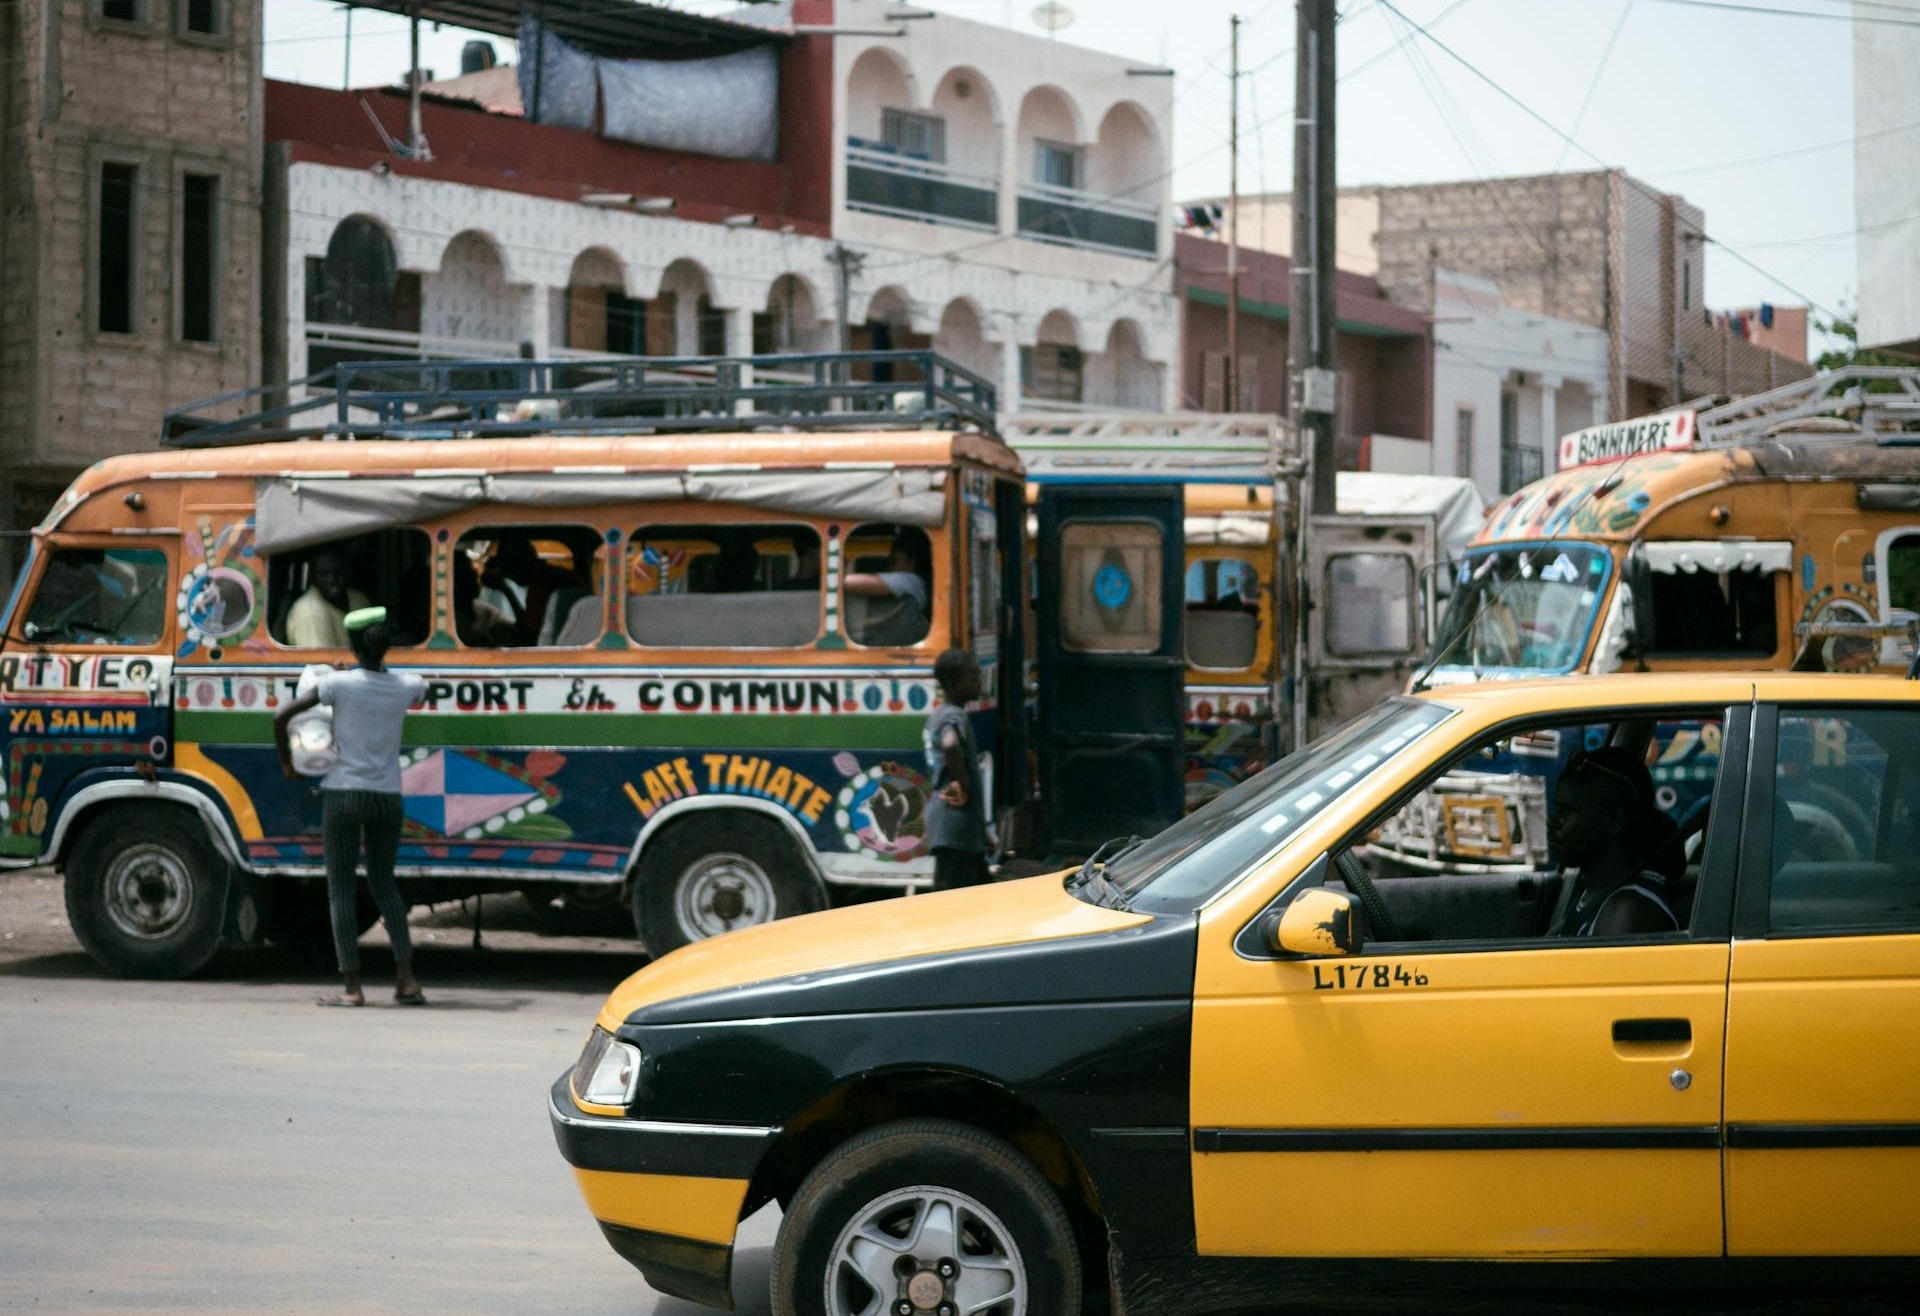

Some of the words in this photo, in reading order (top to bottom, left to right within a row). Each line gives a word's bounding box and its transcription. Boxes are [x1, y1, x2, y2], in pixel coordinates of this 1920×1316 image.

[284, 680, 534, 711] TPORT
[638, 680, 840, 712] COMMUN
[9, 708, 45, 734] YA
[48, 708, 137, 734] SALAM
[623, 756, 698, 819] LAFF
[703, 753, 832, 828] THIATE
[1313, 963, 1429, 990] L17846
